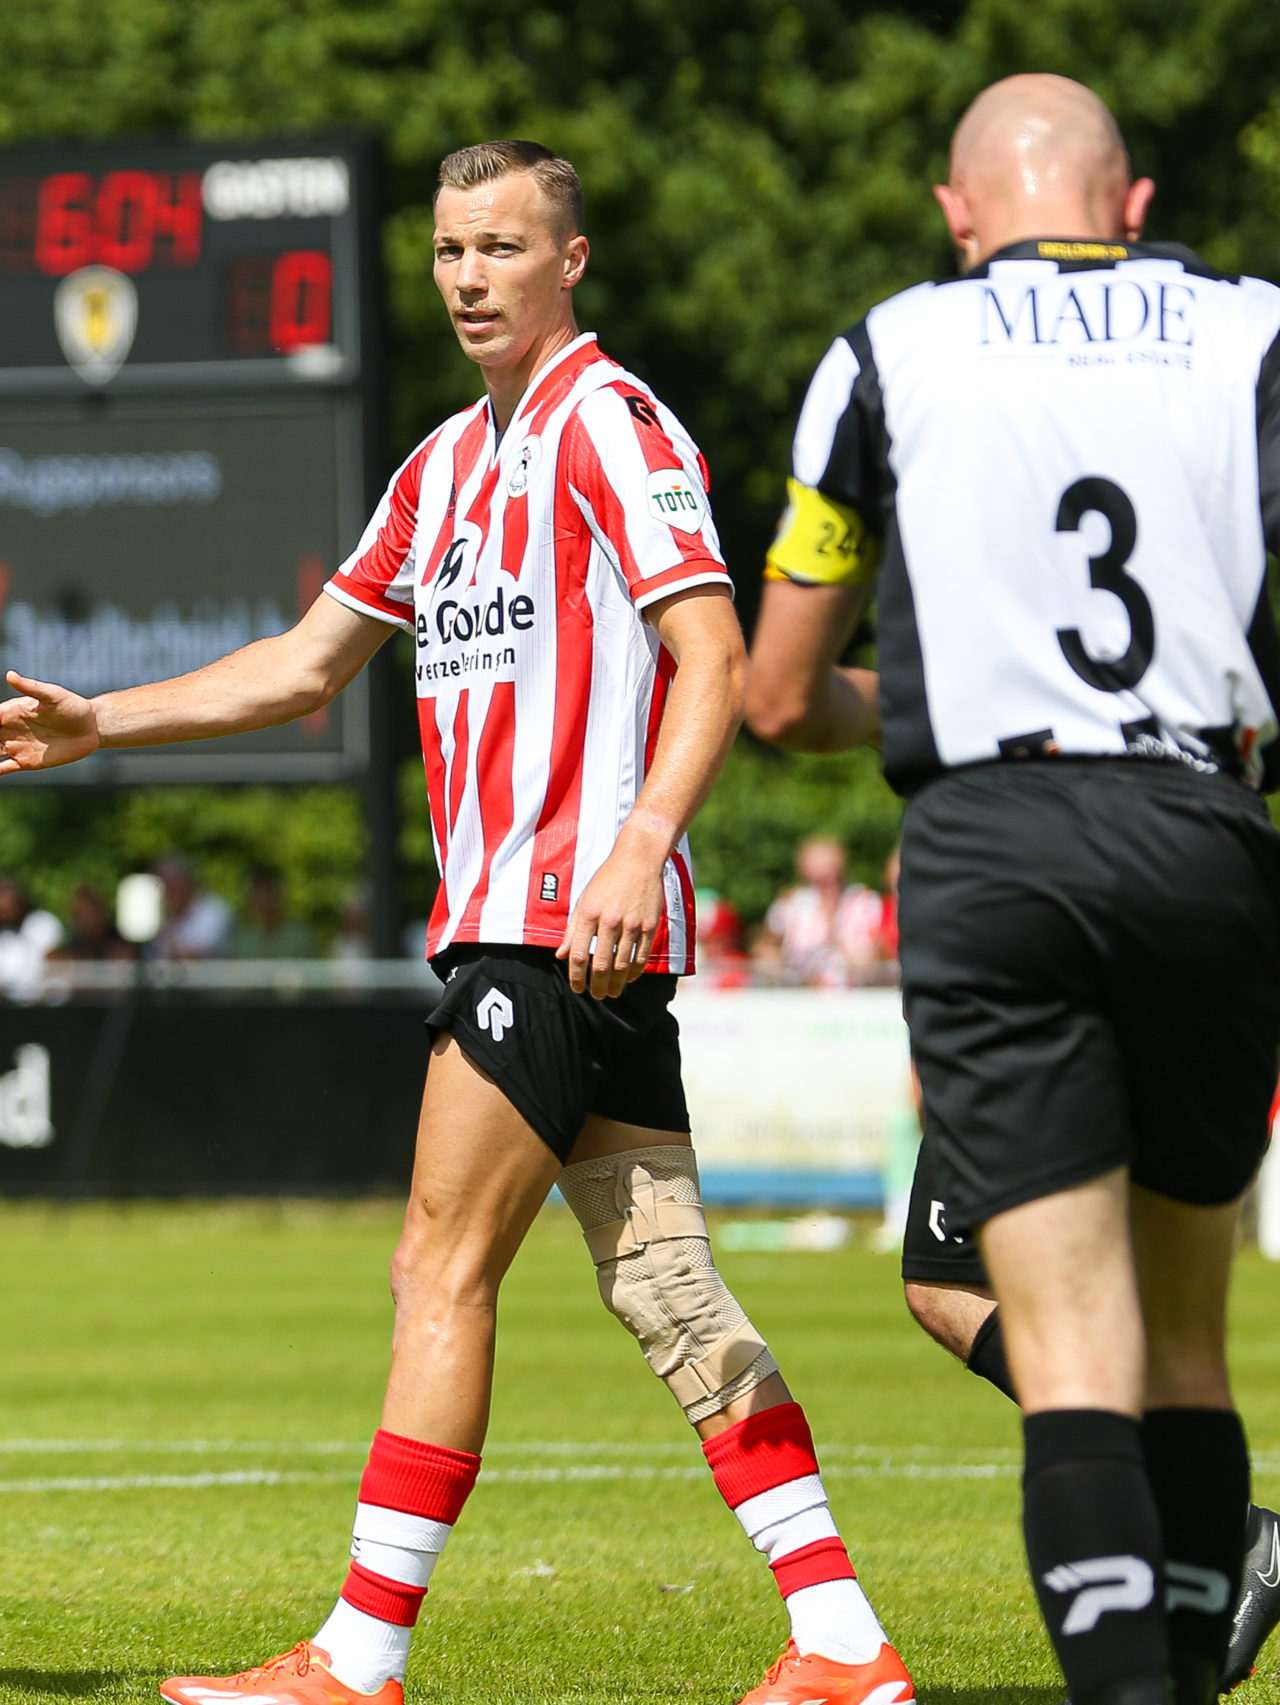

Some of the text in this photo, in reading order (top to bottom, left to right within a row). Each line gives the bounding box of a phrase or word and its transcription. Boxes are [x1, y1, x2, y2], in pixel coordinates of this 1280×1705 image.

[269, 250, 332, 355] 0
[978, 280, 1196, 346] MADE
[652, 491, 697, 512] TOTO
[1056, 474, 1155, 693] 3
